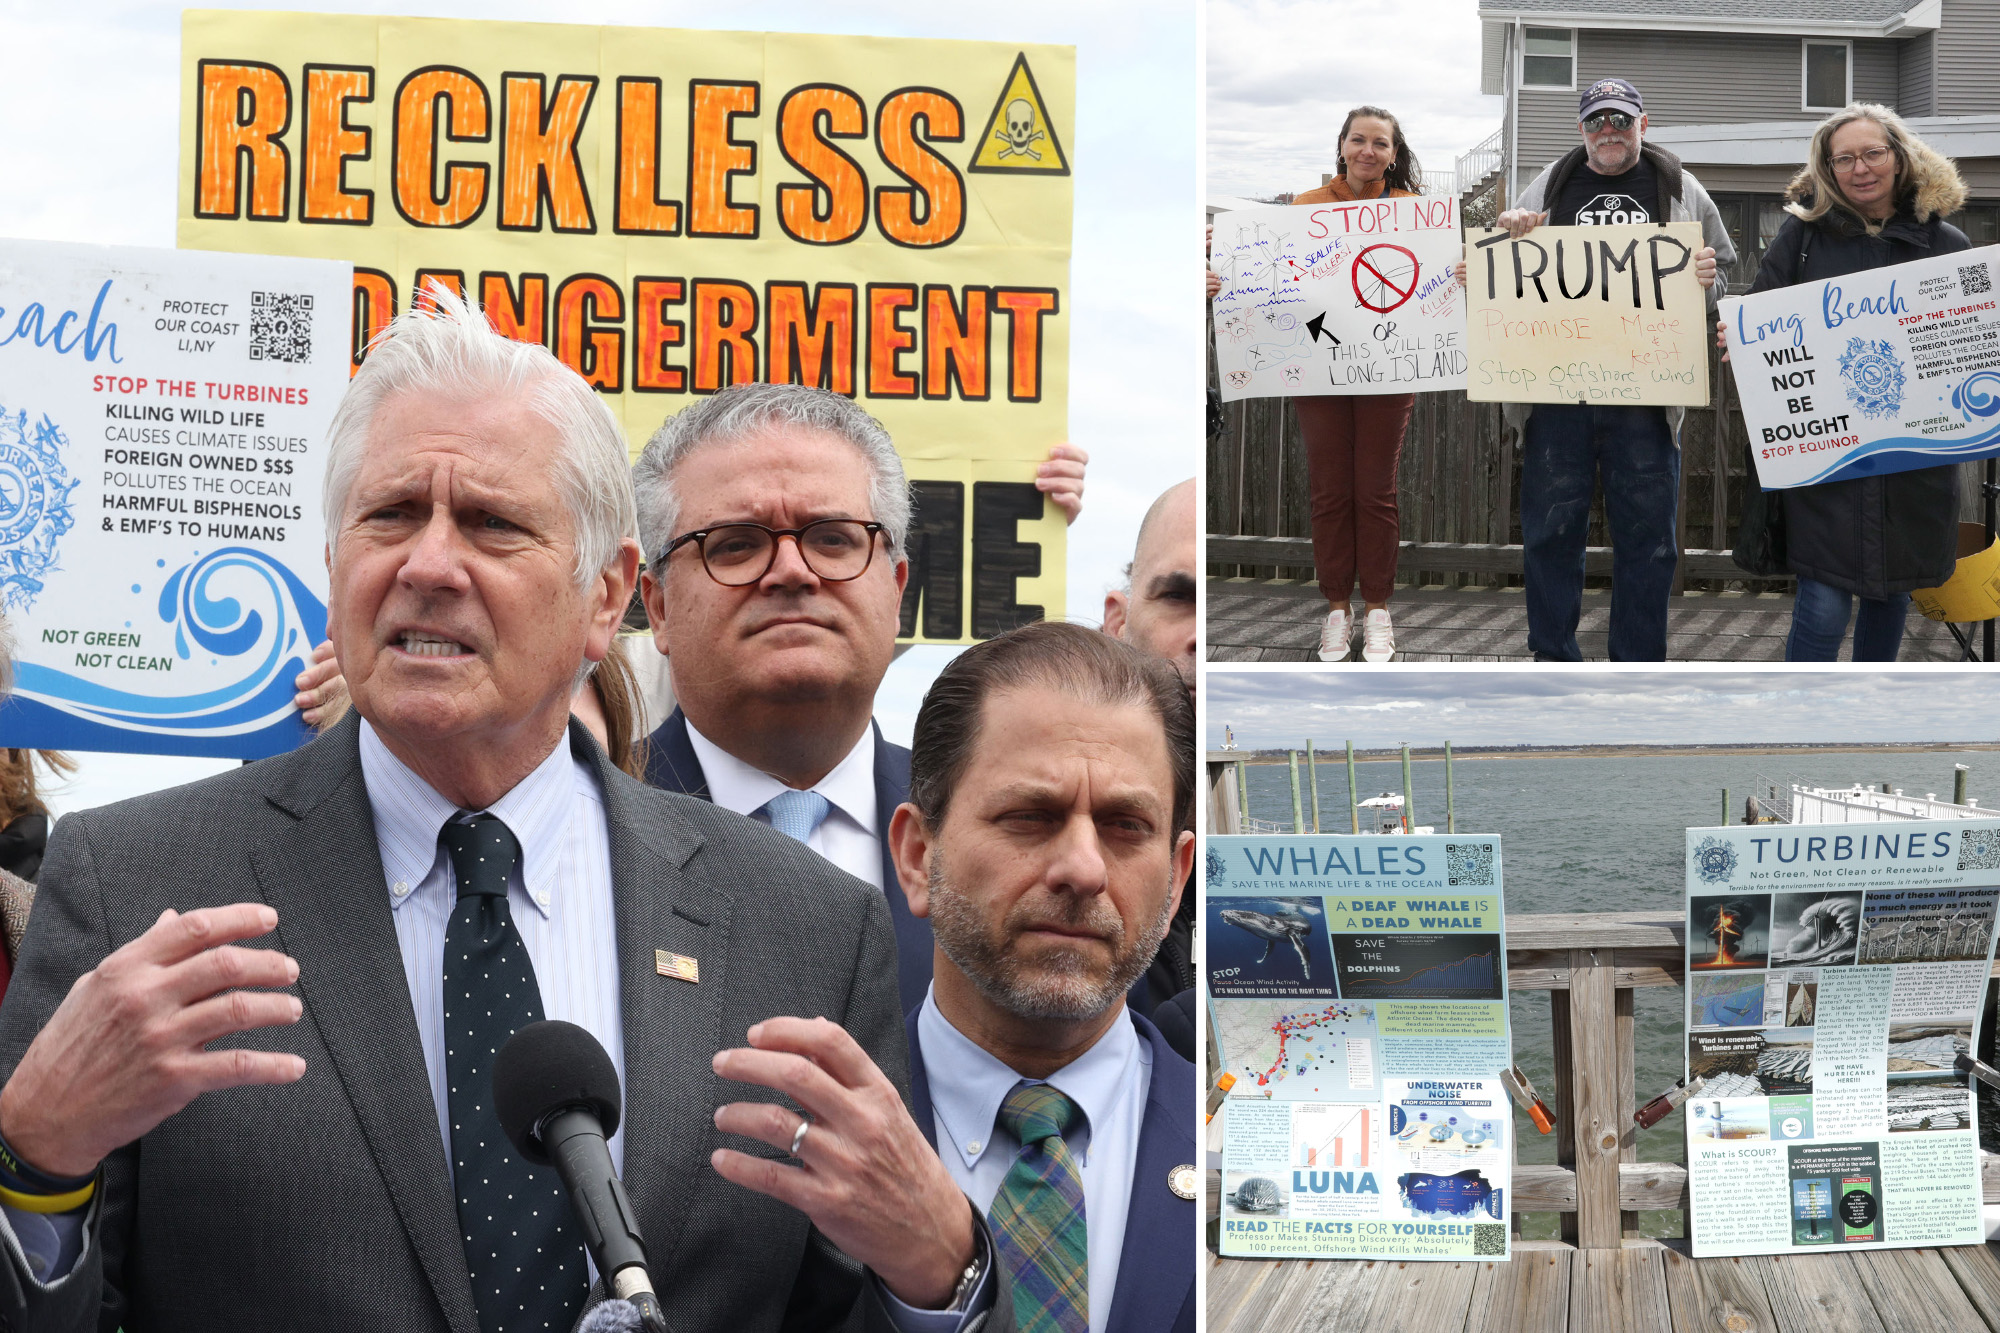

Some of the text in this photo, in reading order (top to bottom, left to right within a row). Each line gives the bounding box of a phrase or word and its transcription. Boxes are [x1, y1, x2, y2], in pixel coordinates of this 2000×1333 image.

[194, 58, 967, 249] RECKLESS
[1308, 197, 1452, 239] STOP! NO!
[1579, 210, 1647, 226] STOP
[1305, 237, 1342, 268] SEALIFE
[1475, 231, 1691, 310] TRUMP
[1415, 266, 1455, 301] WHALE
[1918, 283, 1957, 295] OUR COAST
[1920, 277, 1949, 287] PROTECT
[163, 301, 228, 316] PROTECT
[1737, 280, 1909, 347] Long Beach
[1898, 301, 1996, 326] STOP THE TURBINES
[155, 319, 240, 336] OUR COAST
[1373, 322, 1400, 341] OR
[1620, 314, 1684, 335] Made
[1907, 316, 1979, 334] KILLING WILD LIFE
[1909, 321, 2000, 344] CAUSES CLIMATE ISSUES
[1327, 332, 1459, 361] THIS WILL BE
[1652, 337, 1660, 346] &
[1912, 332, 1998, 352] FOREIGN OWNED $$$
[1763, 345, 1814, 367] WILL
[1914, 341, 1999, 362] POLLUTES THE OCEAN
[1329, 351, 1467, 386] LONG ISLAND
[1916, 358, 1954, 370] HARMFUL
[1927, 367, 1950, 379] EMF'S
[1952, 366, 1962, 374] TO
[1965, 360, 2000, 372] HUMANS
[1478, 360, 1537, 391] Stop
[1771, 370, 1816, 392] NOT
[93, 375, 309, 405] STOP THE TURBINES
[1787, 396, 1814, 414] BE
[106, 404, 265, 428] KILLING WILD LIFE
[1905, 416, 1949, 428] NOT GREEN
[1761, 415, 1849, 443] BOUGHT
[1922, 423, 1965, 435] NOT CLEAN
[105, 426, 308, 453] CAUSES CLIMATE ISSUES
[1800, 436, 1859, 453] EQUINOR
[104, 449, 294, 475] FOREIGN OWNED $$$
[104, 471, 291, 497] POLLUTES THE OCEAN
[102, 494, 302, 520] HARMFUL BISPHENOLS
[102, 517, 286, 542] & EMF'S TO HUMANS
[42, 629, 141, 648] NOT GREEN
[75, 653, 172, 671] NOT CLEAN
[1750, 832, 1952, 864] TURBINES
[1243, 846, 1426, 876] WHALES
[1773, 870, 1808, 878] Green,
[1836, 868, 1866, 876] Clean
[1886, 865, 1944, 874] Renewable
[1232, 880, 1260, 889] SAVE
[1402, 880, 1442, 888] OCEAN
[1908, 891, 1934, 899] these
[1938, 890, 1956, 898] will
[1959, 890, 1999, 898] produce
[1336, 900, 1488, 911] A DEAF WHALE IS
[1346, 917, 1482, 928] A DEAD WHALE
[1355, 939, 1385, 948] SAVE
[1362, 952, 1382, 960] THE
[1212, 968, 1240, 978] STOP
[1408, 1082, 1482, 1090] UNDERWATER
[1429, 1090, 1462, 1098] NOISE
[1738, 1148, 1776, 1158] SCOUR?
[1292, 1171, 1380, 1194] LUNA
[1226, 1220, 1472, 1236] READ THE FACTS FOR YOURSELF
[1229, 1232, 1274, 1242] Professor
[1278, 1234, 1308, 1242] Makes
[1312, 1234, 1354, 1244] Stunning
[1359, 1234, 1410, 1244] Discovery:
[1270, 1244, 1310, 1254] percent,
[1389, 1245, 1410, 1253] Kills
